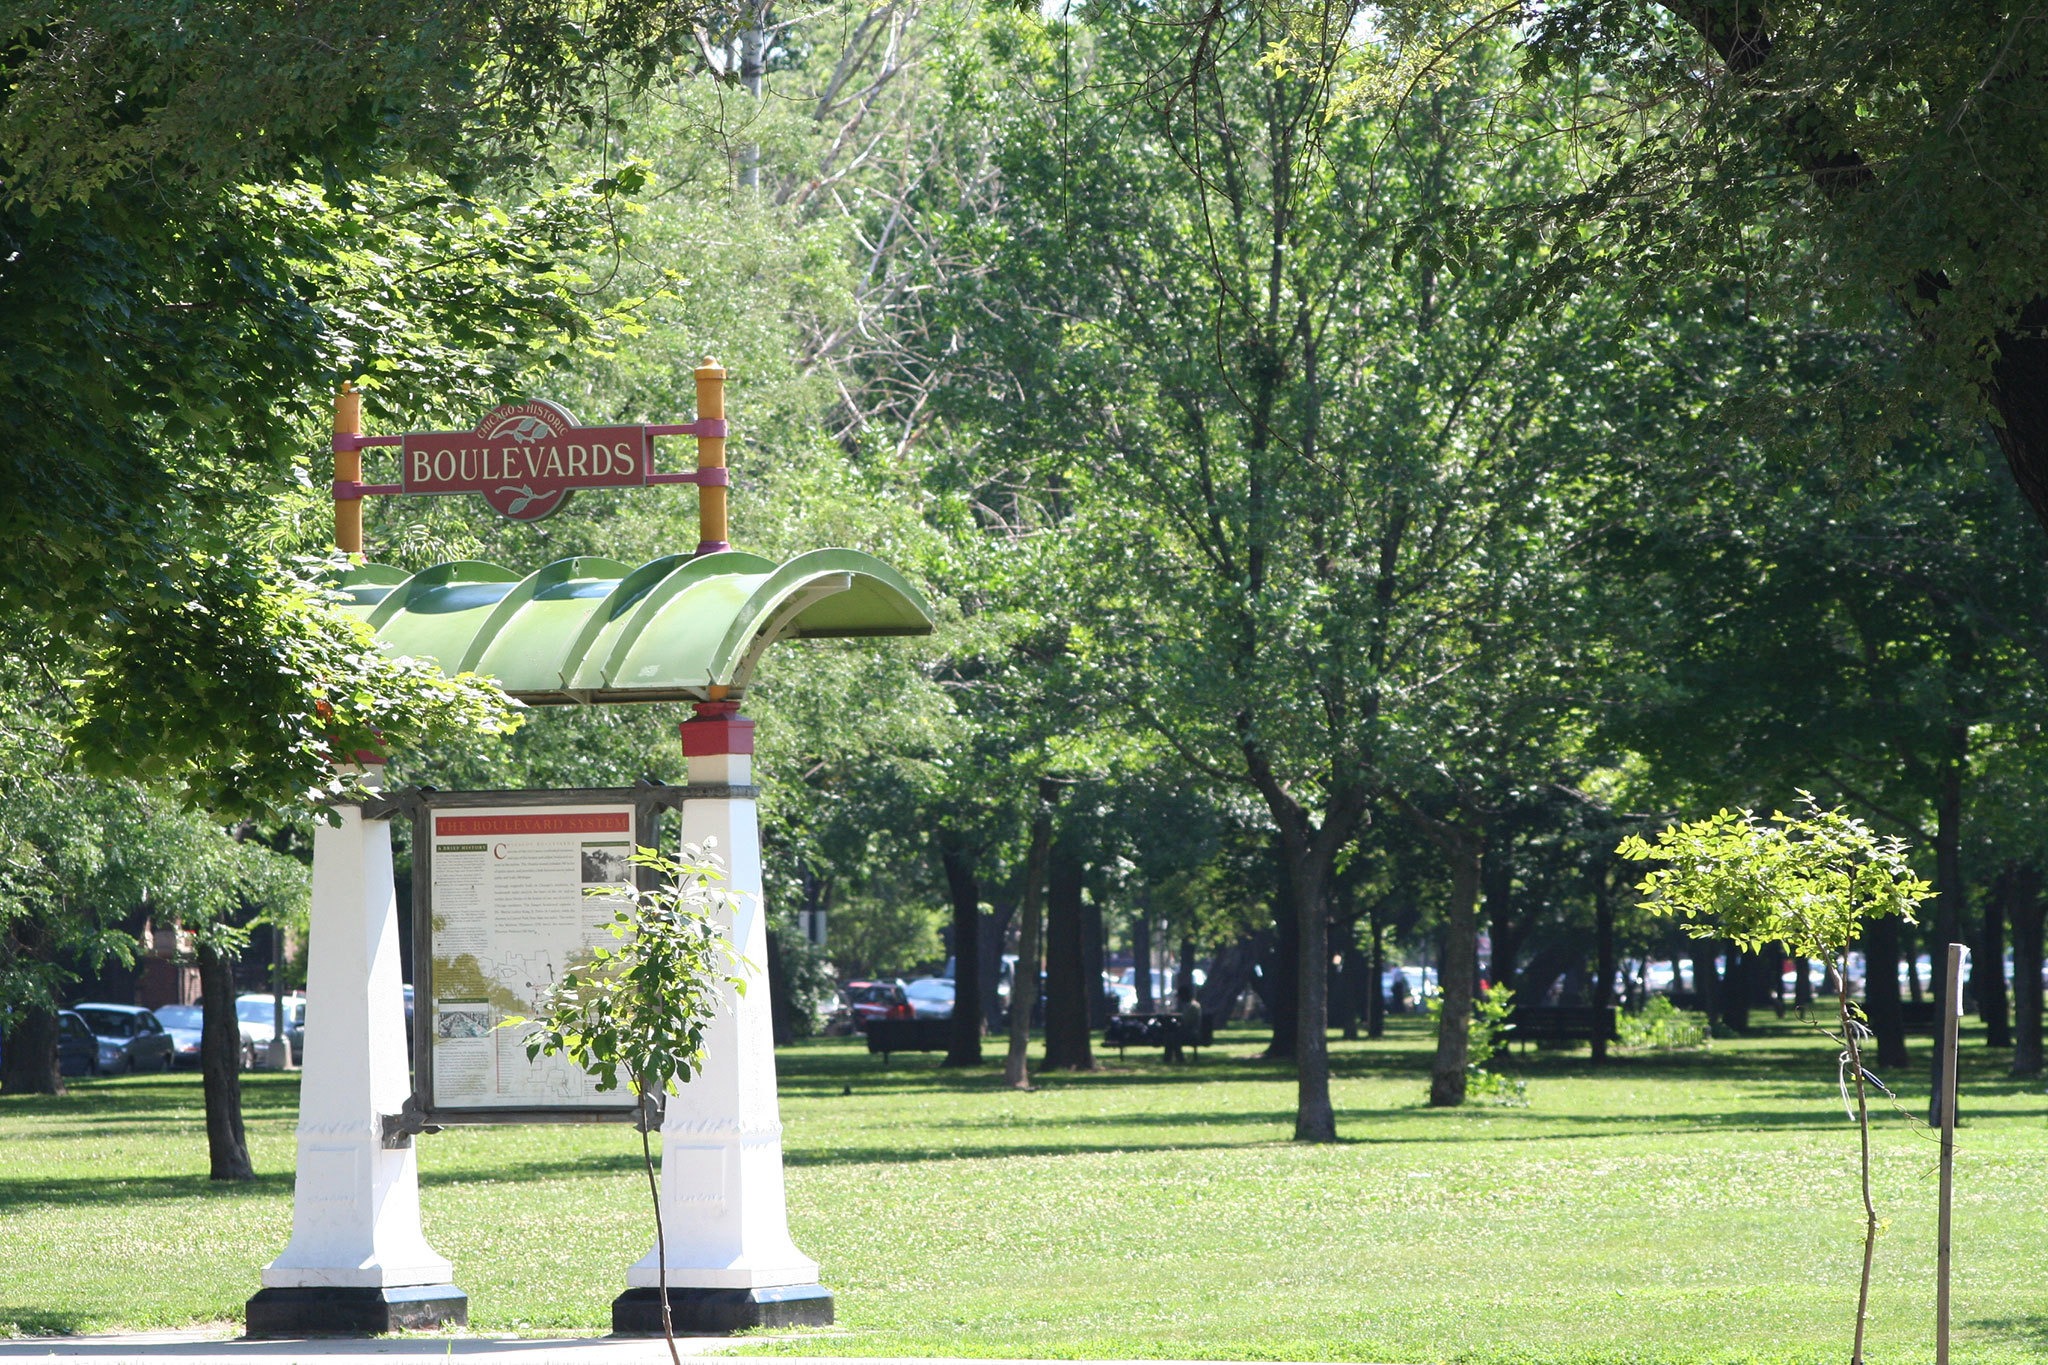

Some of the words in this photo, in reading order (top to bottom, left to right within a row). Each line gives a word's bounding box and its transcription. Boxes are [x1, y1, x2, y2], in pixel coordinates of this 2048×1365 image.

[477, 404, 524, 439] CHICGOS
[526, 404, 569, 437] HISTORIC
[412, 443, 636, 482] BOULEVARDS
[438, 821, 467, 833] THE
[473, 818, 563, 832] BOULEVARD
[569, 816, 627, 830] SYSTEM
